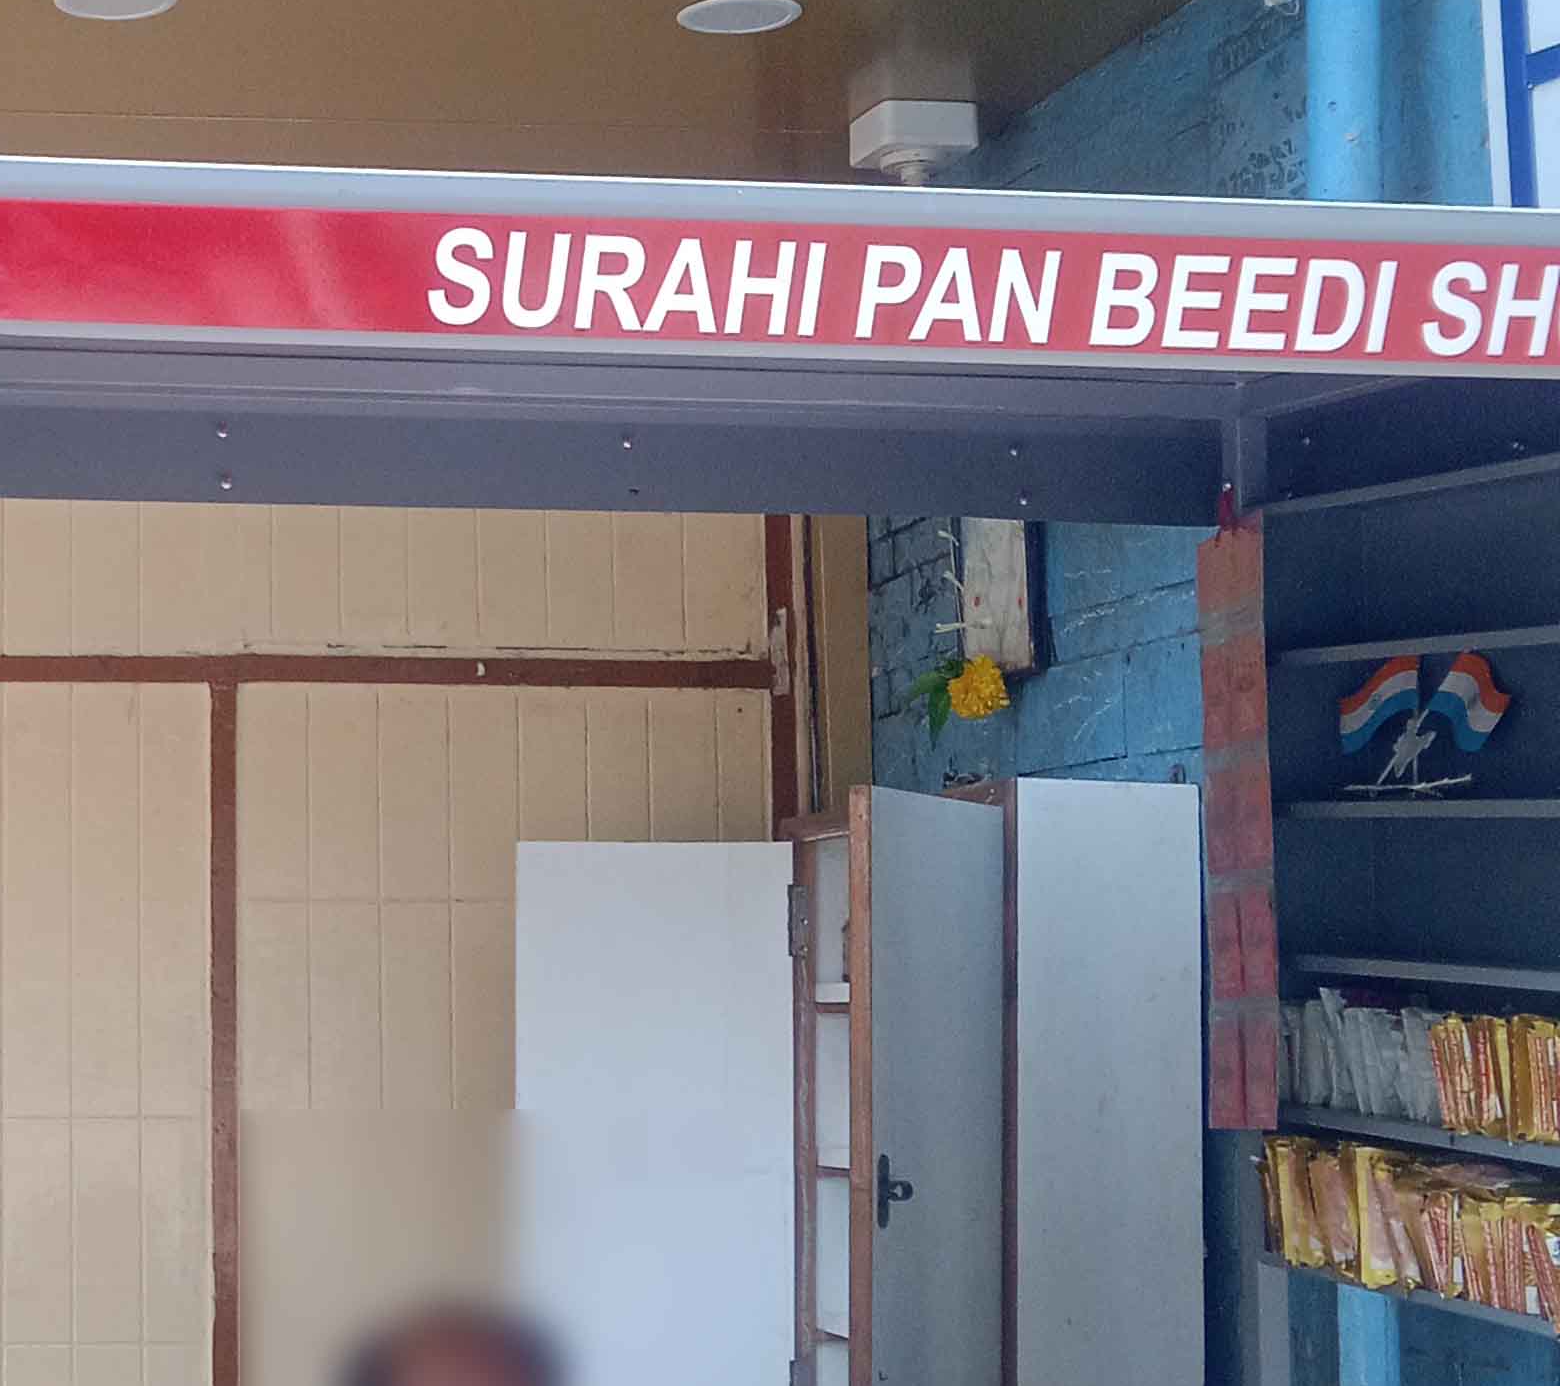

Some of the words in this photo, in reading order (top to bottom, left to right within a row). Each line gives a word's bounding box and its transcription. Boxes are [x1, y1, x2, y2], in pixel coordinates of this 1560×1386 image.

[427, 226, 827, 337] SURAHI
[855, 243, 1063, 345] PAN
[1088, 252, 1399, 354] BEEDI
